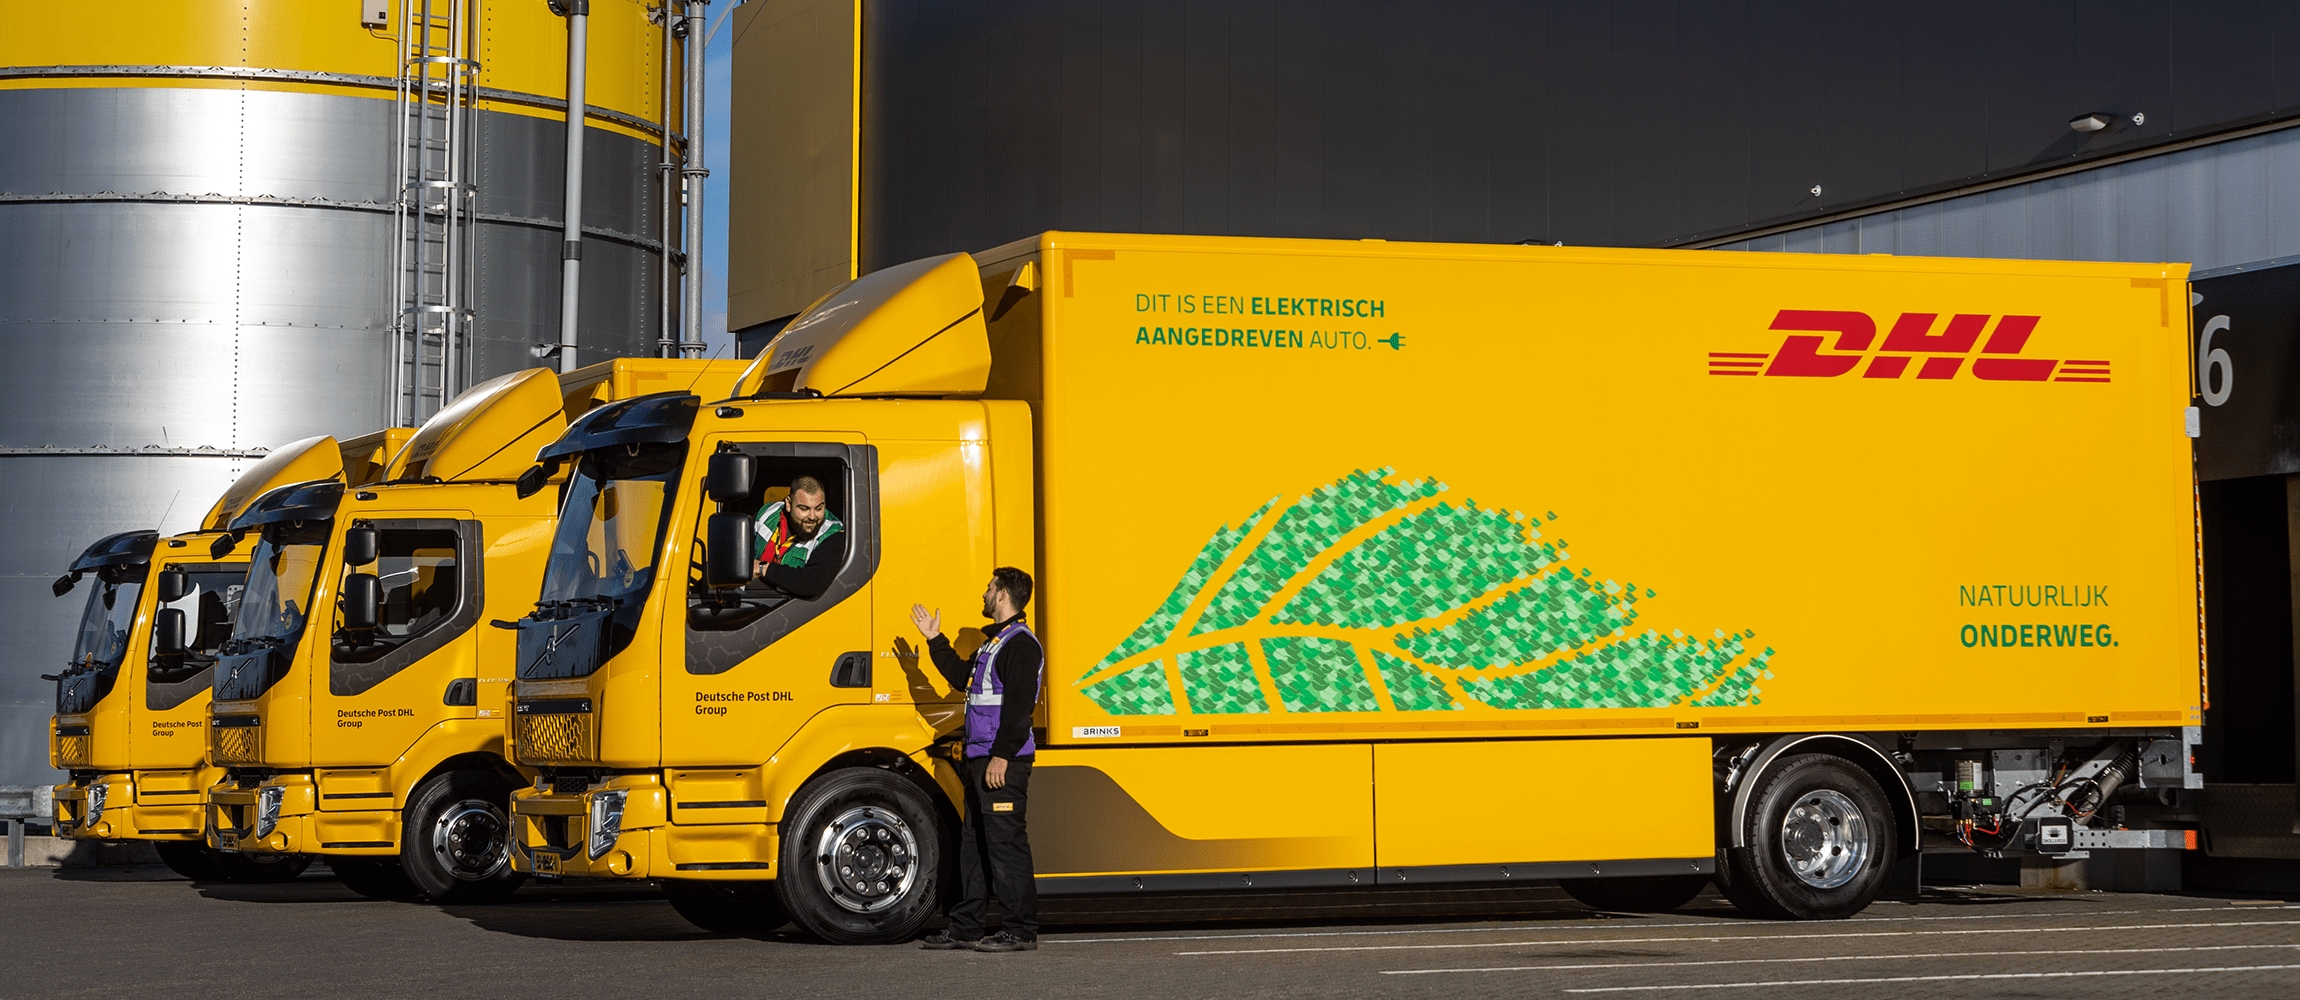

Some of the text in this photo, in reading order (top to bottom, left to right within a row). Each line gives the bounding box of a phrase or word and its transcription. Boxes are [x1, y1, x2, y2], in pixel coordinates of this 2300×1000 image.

[1136, 293, 1385, 318] DIT IS EEN ELEKTRISCH
[1135, 326, 1371, 350] AANGEDREVEN AUTO.
[1764, 309, 2059, 382] DHL
[2198, 314, 2233, 407] 6
[1960, 585, 2109, 607] NATUURLIJK
[1960, 623, 2119, 648] ONDERWEG.
[695, 691, 794, 702] Deutsche Post DHL
[337, 708, 415, 718] Deutsche Post DHL
[695, 704, 728, 717] Group
[152, 720, 186, 728] Deutsche
[186, 720, 203, 728] Post
[337, 719, 363, 729] Group
[152, 729, 174, 738] Group
[1083, 728, 1120, 736] BRINKS
